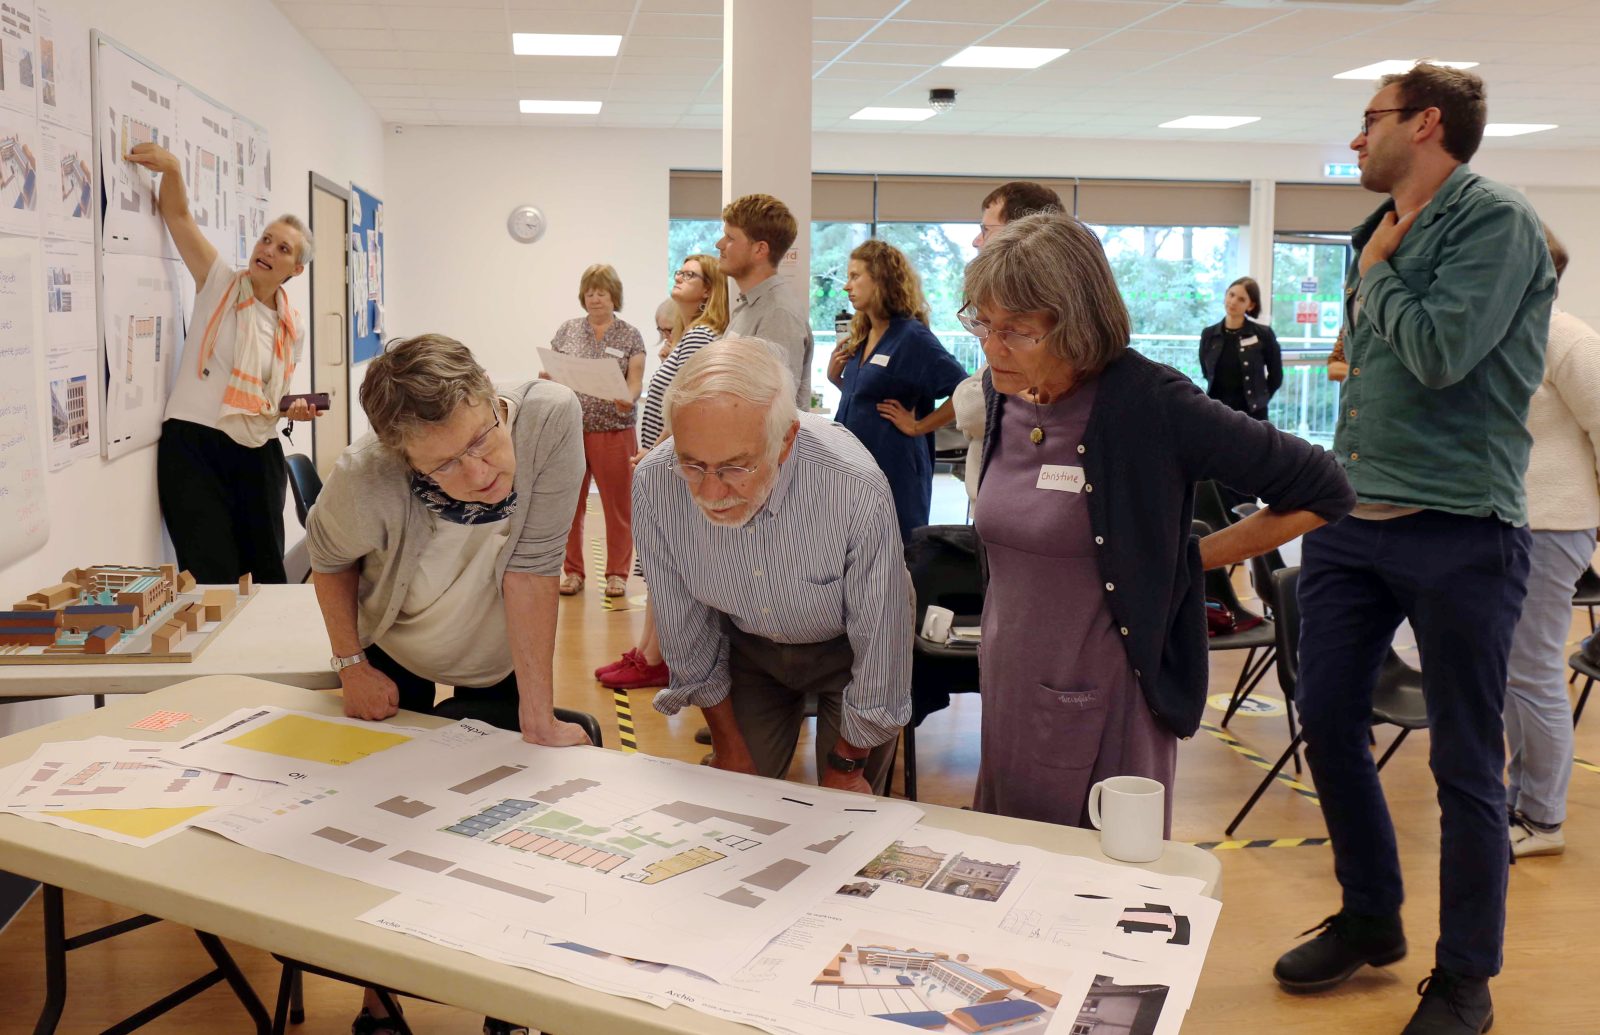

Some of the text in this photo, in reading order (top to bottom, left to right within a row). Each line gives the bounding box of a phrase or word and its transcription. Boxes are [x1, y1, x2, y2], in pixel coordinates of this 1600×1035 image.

[1041, 472, 1078, 484] Christine
[460, 723, 490, 737] Archio
[376, 918, 401, 929] Archio
[664, 989, 696, 1003] Archio
